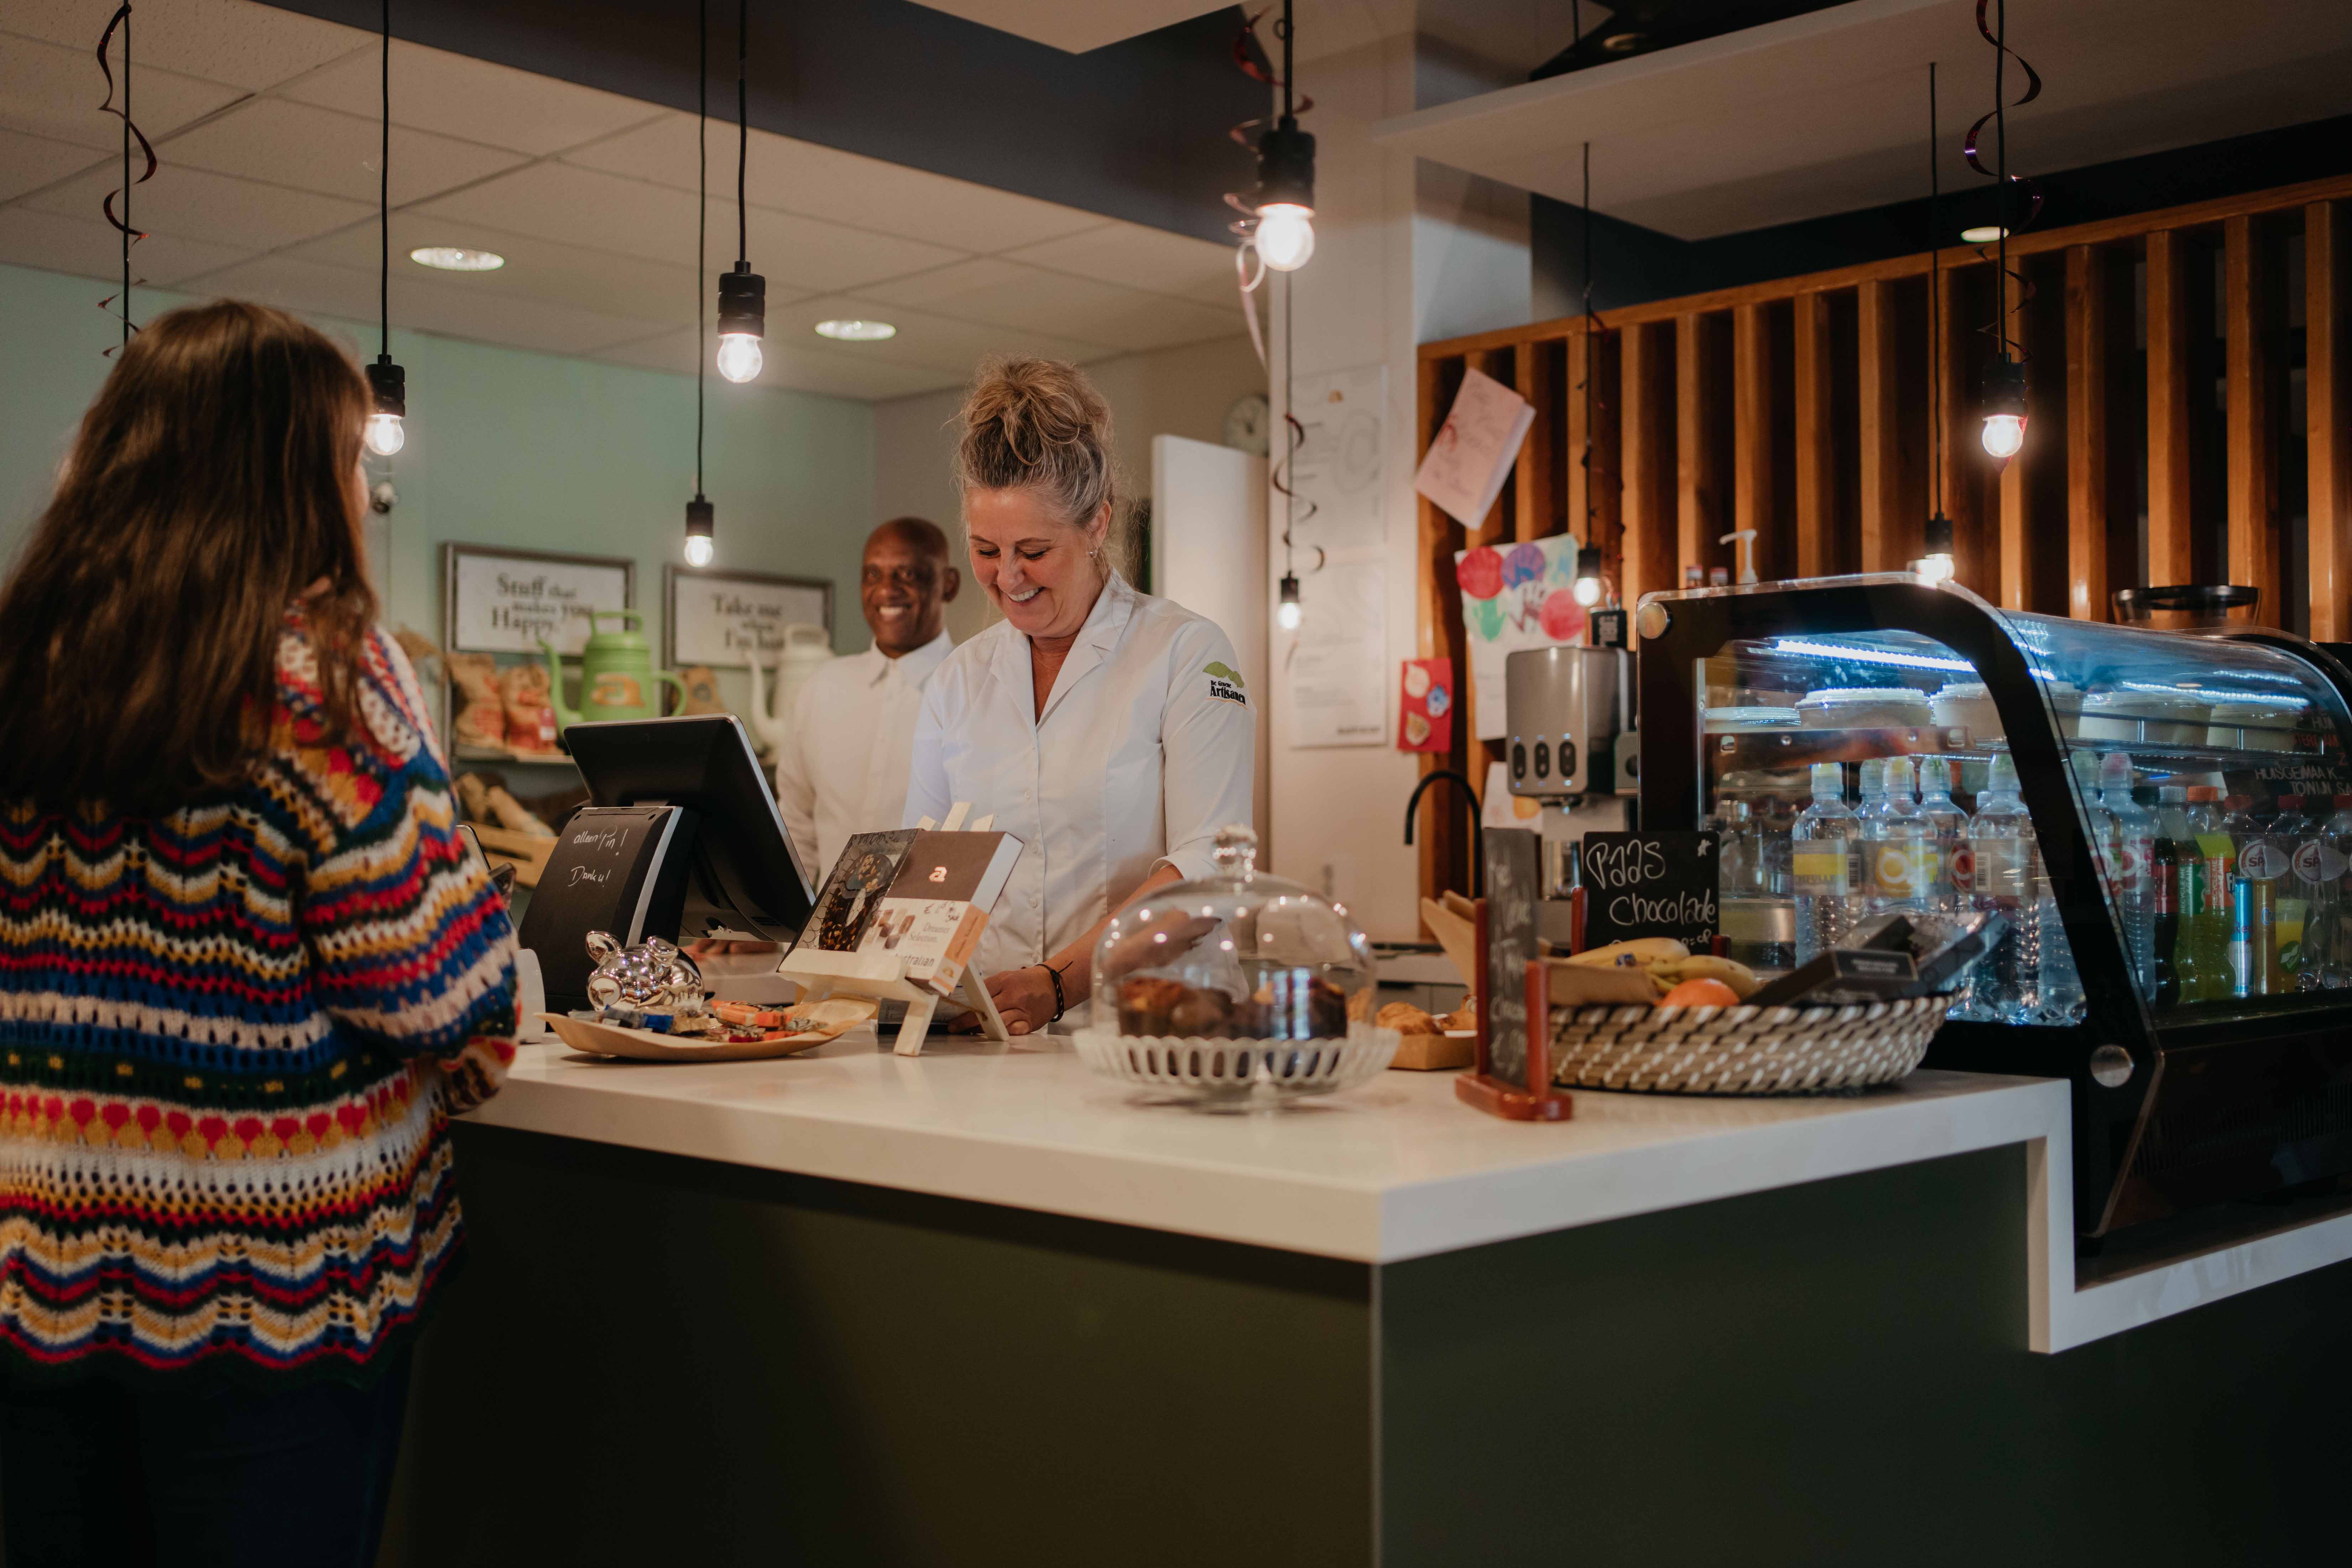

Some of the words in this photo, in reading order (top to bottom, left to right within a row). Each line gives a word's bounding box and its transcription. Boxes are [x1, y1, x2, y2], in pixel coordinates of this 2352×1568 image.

[497, 572, 548, 598] Stuff
[710, 593, 753, 615] Take
[758, 603, 783, 617] me
[573, 830, 598, 844] alleen
[568, 866, 596, 887] Dank
[929, 866, 947, 883] a
[1609, 888, 1716, 926] Chocolade
[923, 922, 950, 933] Dreamer
